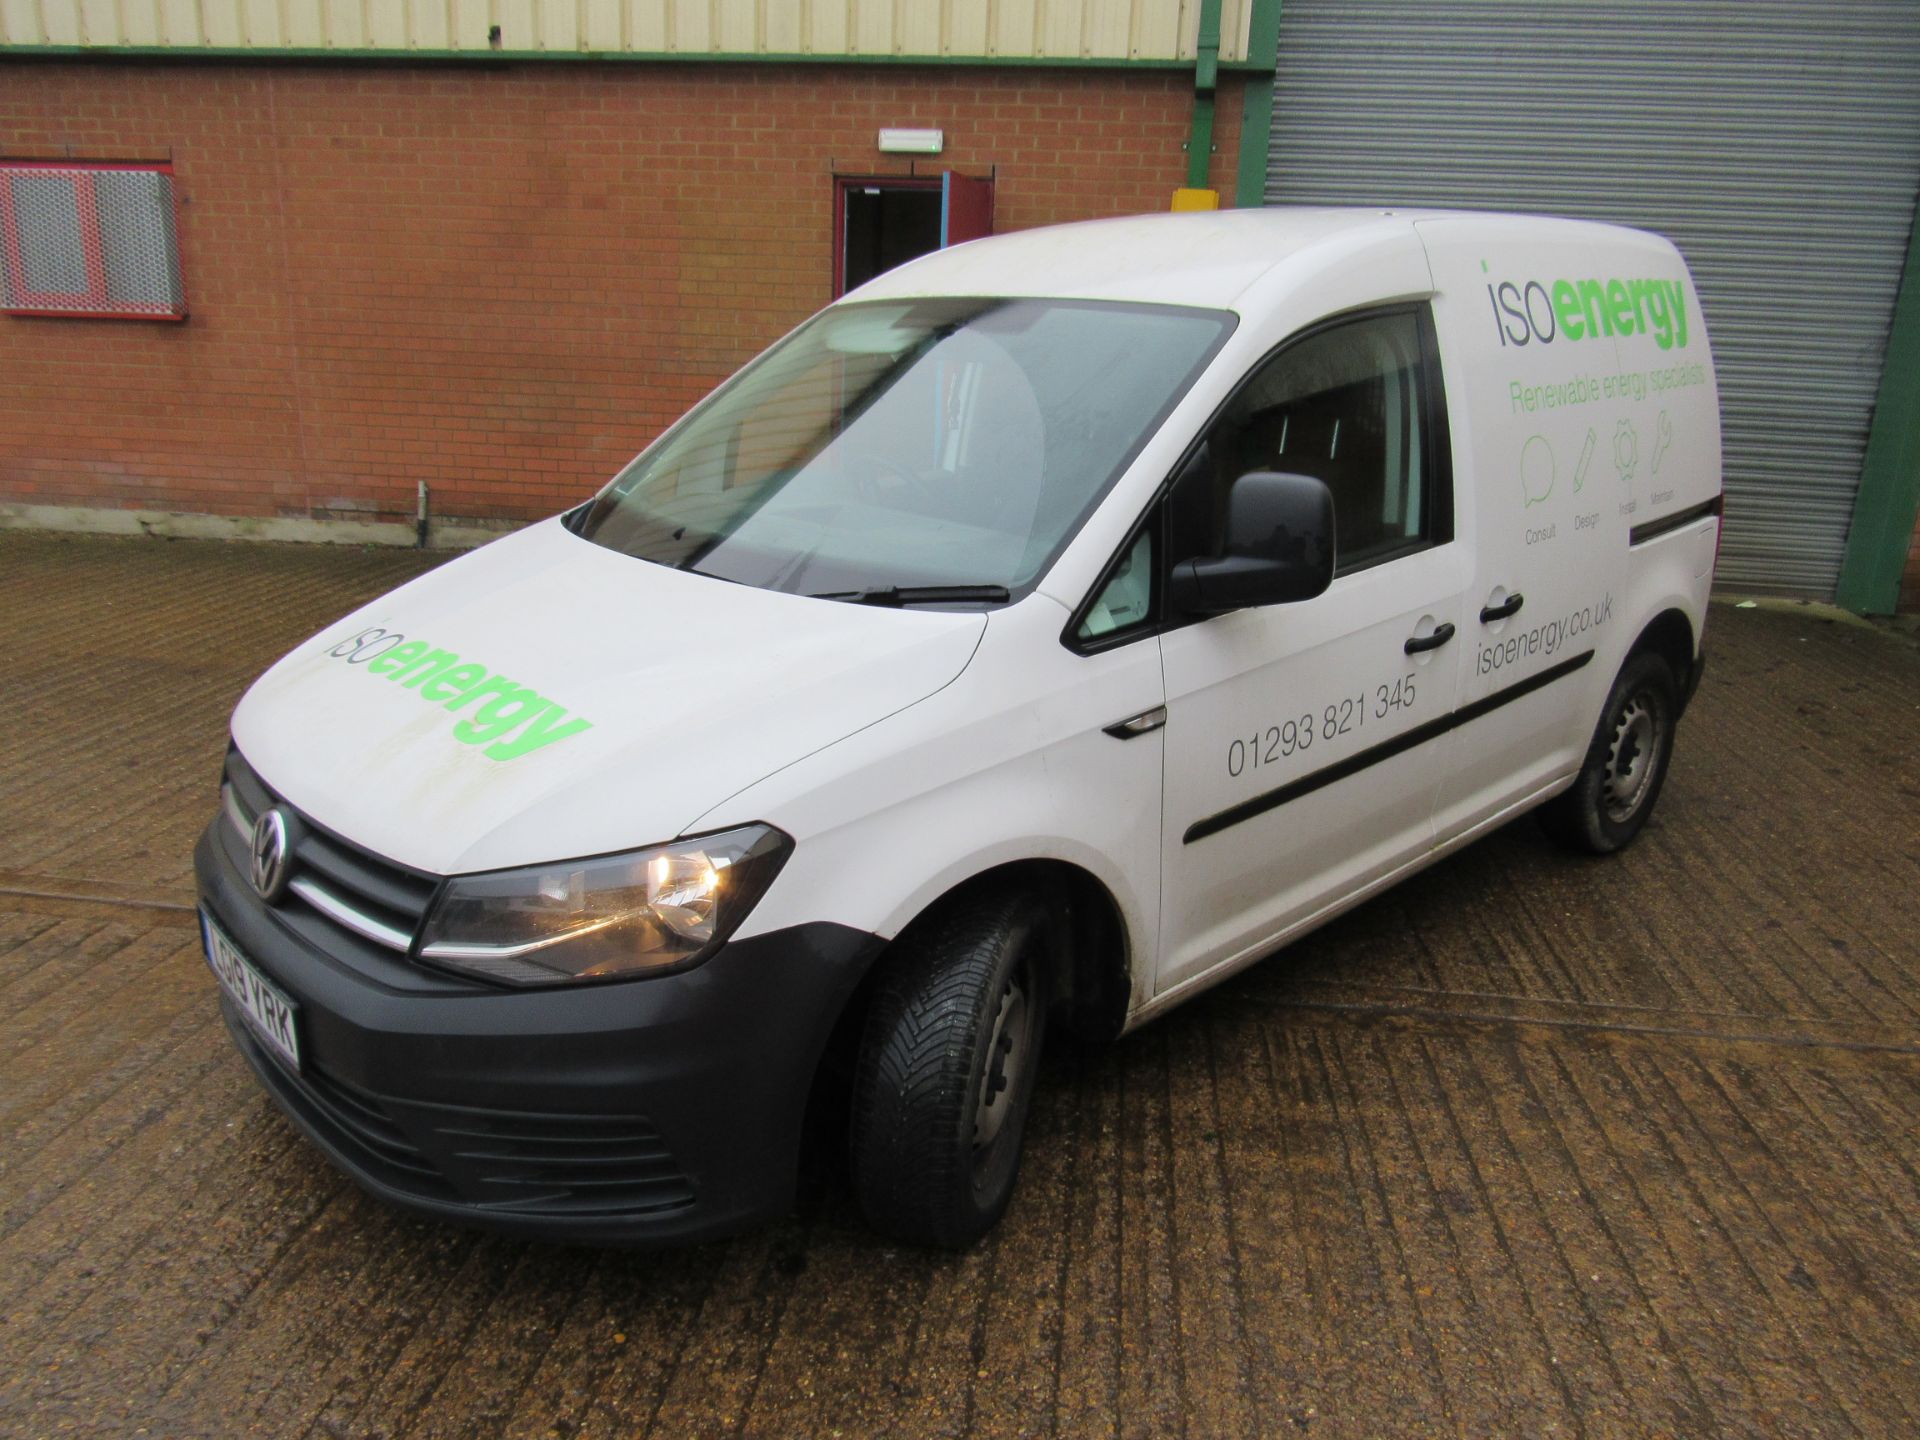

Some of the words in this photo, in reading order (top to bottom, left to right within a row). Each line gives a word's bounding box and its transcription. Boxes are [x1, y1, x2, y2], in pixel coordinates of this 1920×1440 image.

[1481, 259, 1688, 350] isoenergy
[1509, 374, 1600, 414] Renewable
[1603, 372, 1647, 401] energy
[1526, 524, 1556, 545] Consult
[1574, 511, 1600, 530] Design
[1477, 592, 1613, 676] isoenergy.co.uk
[323, 617, 594, 762] isoenergy
[1228, 714, 1314, 777] 01293
[1322, 693, 1366, 740] 821
[1375, 673, 1417, 719] 345
[248, 970, 294, 1053] YRK
